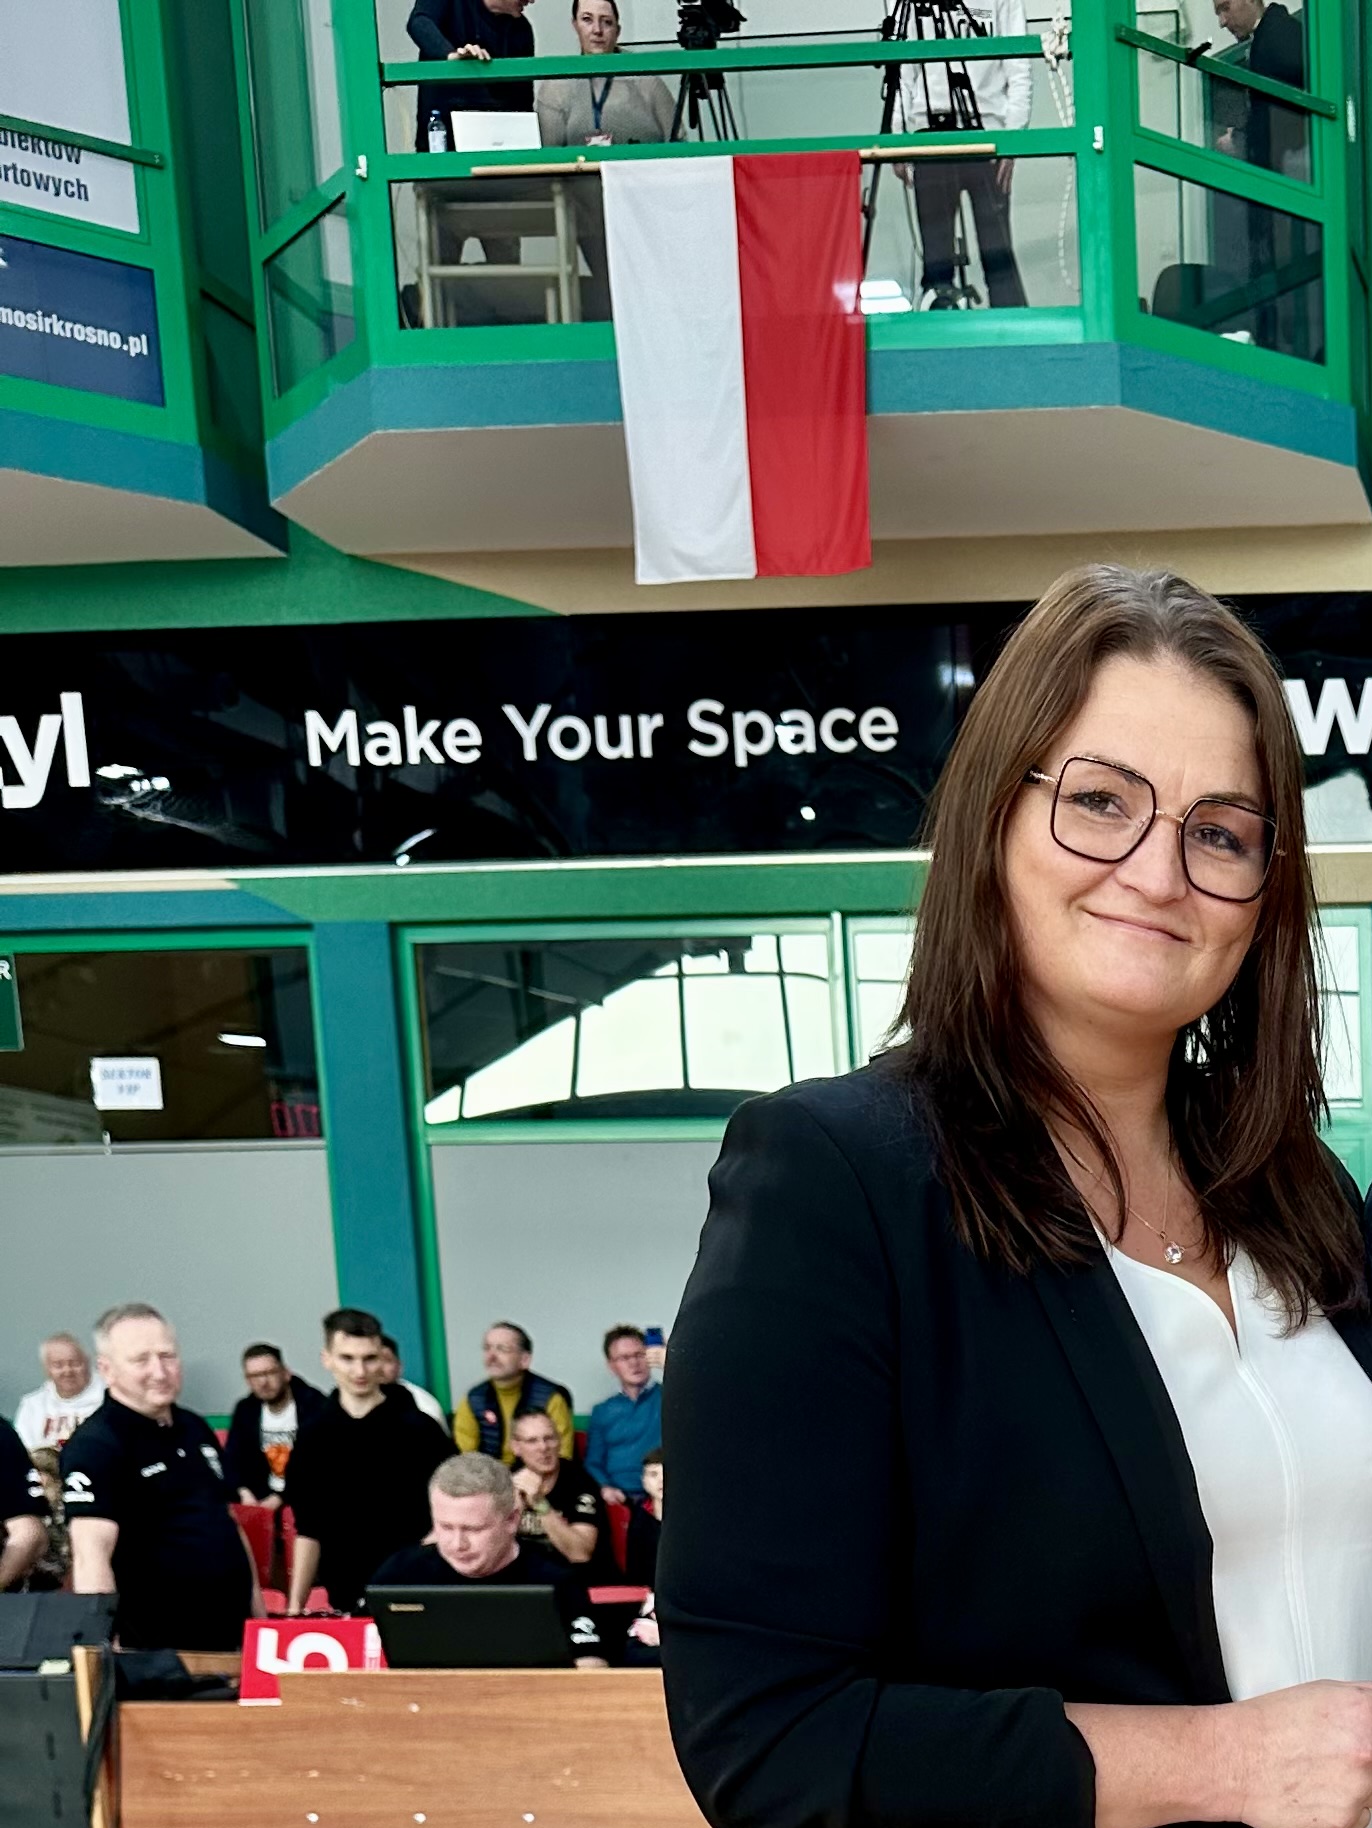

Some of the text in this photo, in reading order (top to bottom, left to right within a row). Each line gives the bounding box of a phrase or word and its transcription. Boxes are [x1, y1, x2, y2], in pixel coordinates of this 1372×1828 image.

[304, 698, 899, 768] Make Your Space
